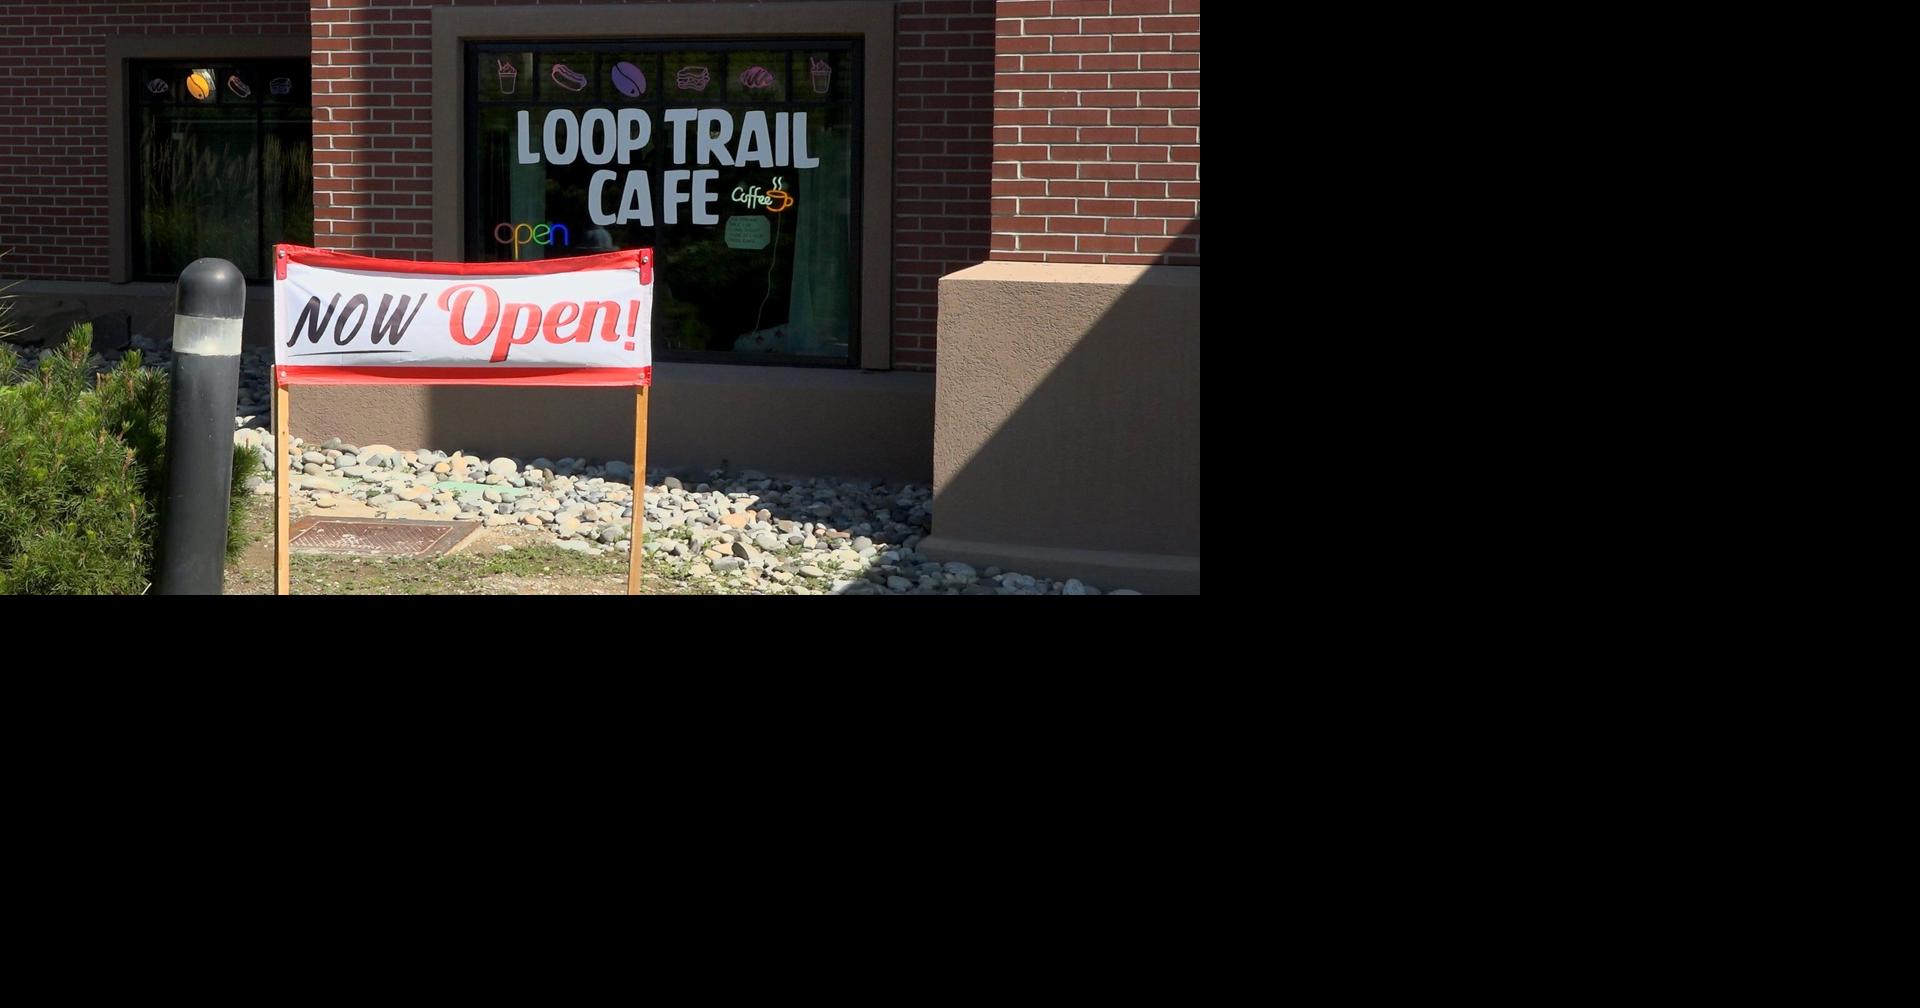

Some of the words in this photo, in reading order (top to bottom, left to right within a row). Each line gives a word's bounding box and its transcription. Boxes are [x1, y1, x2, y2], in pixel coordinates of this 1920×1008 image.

[517, 108, 652, 165] LOOP
[664, 109, 820, 168] TRAIL
[588, 169, 720, 227] CAFE
[731, 186, 773, 209] Coffee
[494, 223, 569, 260] open
[286, 292, 428, 348] NOW
[437, 284, 641, 363] Open!
